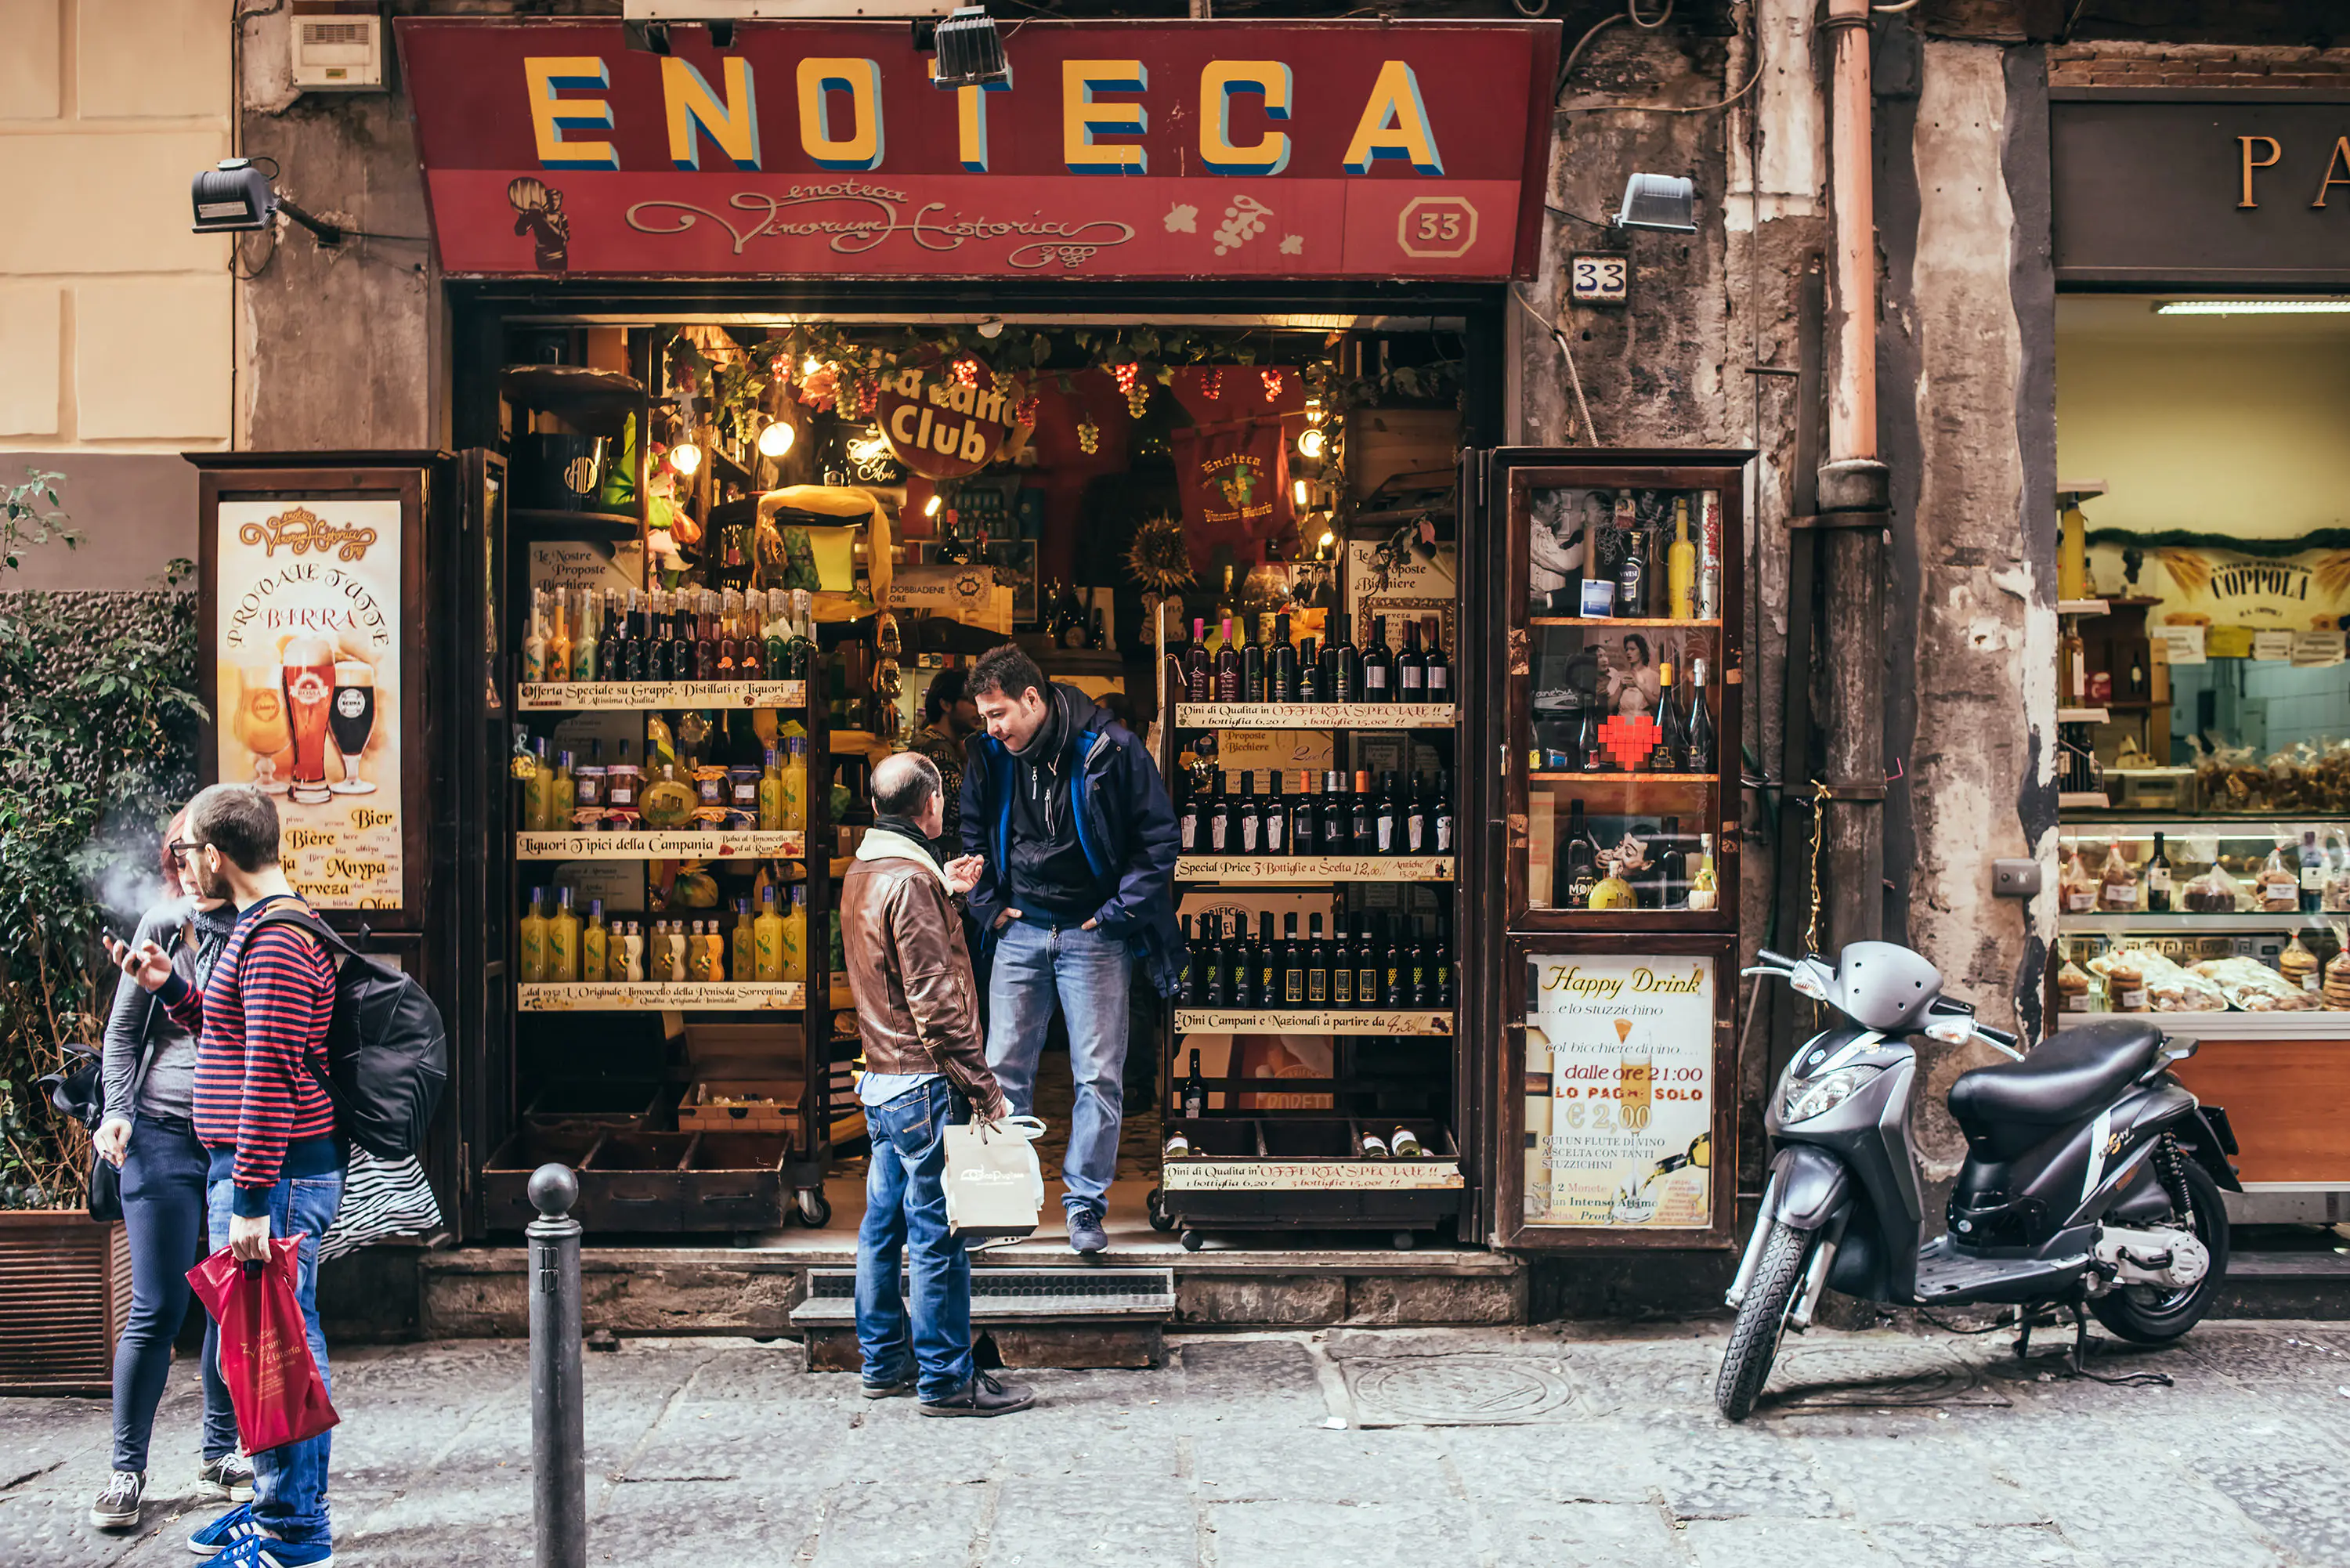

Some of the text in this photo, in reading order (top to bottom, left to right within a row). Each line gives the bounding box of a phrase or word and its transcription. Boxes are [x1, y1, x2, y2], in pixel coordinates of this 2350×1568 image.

[524, 56, 1444, 175] ENOTECA
[782, 178, 909, 202] enoteca
[1417, 212, 1461, 240] 33
[1575, 259, 1625, 295] 33
[891, 404, 986, 464] Club
[1201, 453, 1261, 474] Enoteca
[552, 549, 591, 562] Nostre
[552, 563, 606, 578] Proposte
[890, 586, 945, 595] DOBBIADENE
[2211, 569, 2308, 601] COPPOLA
[325, 568, 389, 647] TUTTE
[260, 608, 356, 632] BIRRA
[521, 685, 562, 699] Offerta
[566, 684, 613, 699] Speciale
[616, 685, 627, 695] su
[680, 682, 731, 697] Distillati
[743, 682, 784, 697] Liquori
[578, 695, 586, 704] di
[1180, 705, 1204, 715] Vini
[1208, 705, 1216, 714] di
[1260, 705, 1269, 714] in
[1272, 705, 1350, 717] OFFERTA
[1354, 705, 1430, 717] SPECIALE
[1208, 717, 1252, 728] bottiglia
[1310, 718, 1354, 728] bottiglie
[1225, 730, 1266, 742] Proposte
[1225, 742, 1269, 753] Bicchiere
[351, 809, 392, 829] Bier
[285, 829, 335, 850] Bière
[519, 837, 713, 855] Liquori Tipici della Campania
[750, 834, 788, 844] Limoncello
[753, 844, 773, 854] Rum
[1179, 862, 1217, 875] Special
[1220, 862, 1250, 876] Price
[1251, 862, 1261, 876] 3
[1262, 862, 1307, 876] Bottiglie
[1318, 862, 1351, 876] Scelta
[1542, 965, 1701, 999] Happy Drink
[625, 985, 671, 999] Limoncello
[674, 986, 693, 995] della
[696, 986, 735, 998] Penisola
[738, 986, 787, 998] Sorrentina
[1558, 1003, 1663, 1016] e lo stuzzichino
[1178, 1014, 1205, 1027] Vini
[1209, 1014, 1256, 1028] Campani
[1269, 1014, 1320, 1028] Nazionali
[1333, 1015, 1369, 1029] partire
[1372, 1016, 1385, 1026] da
[1545, 1041, 1648, 1053] col bicchiere di
[1565, 1064, 1703, 1081] dalle ore 21:00
[1555, 1087, 1578, 1099] LO
[1654, 1088, 1703, 1100] SOLO
[1567, 1102, 1652, 1133] € 2,00
[1542, 1136, 1665, 1147] QUI UN FLUTE DI VINO
[1542, 1148, 1654, 1159] A SCELTA CON TANTI
[1542, 1159, 1613, 1169] STUZZICHINI
[1192, 1166, 1201, 1175] di
[1249, 1166, 1257, 1176] in
[1260, 1166, 1342, 1179] OFFERTA
[1194, 1180, 1238, 1190] bottiglia
[1300, 1180, 1346, 1190] bottiglie
[1557, 1183, 1564, 1192] 2
[1568, 1183, 1607, 1192] Monete
[1570, 1197, 1614, 1207] Intenso
